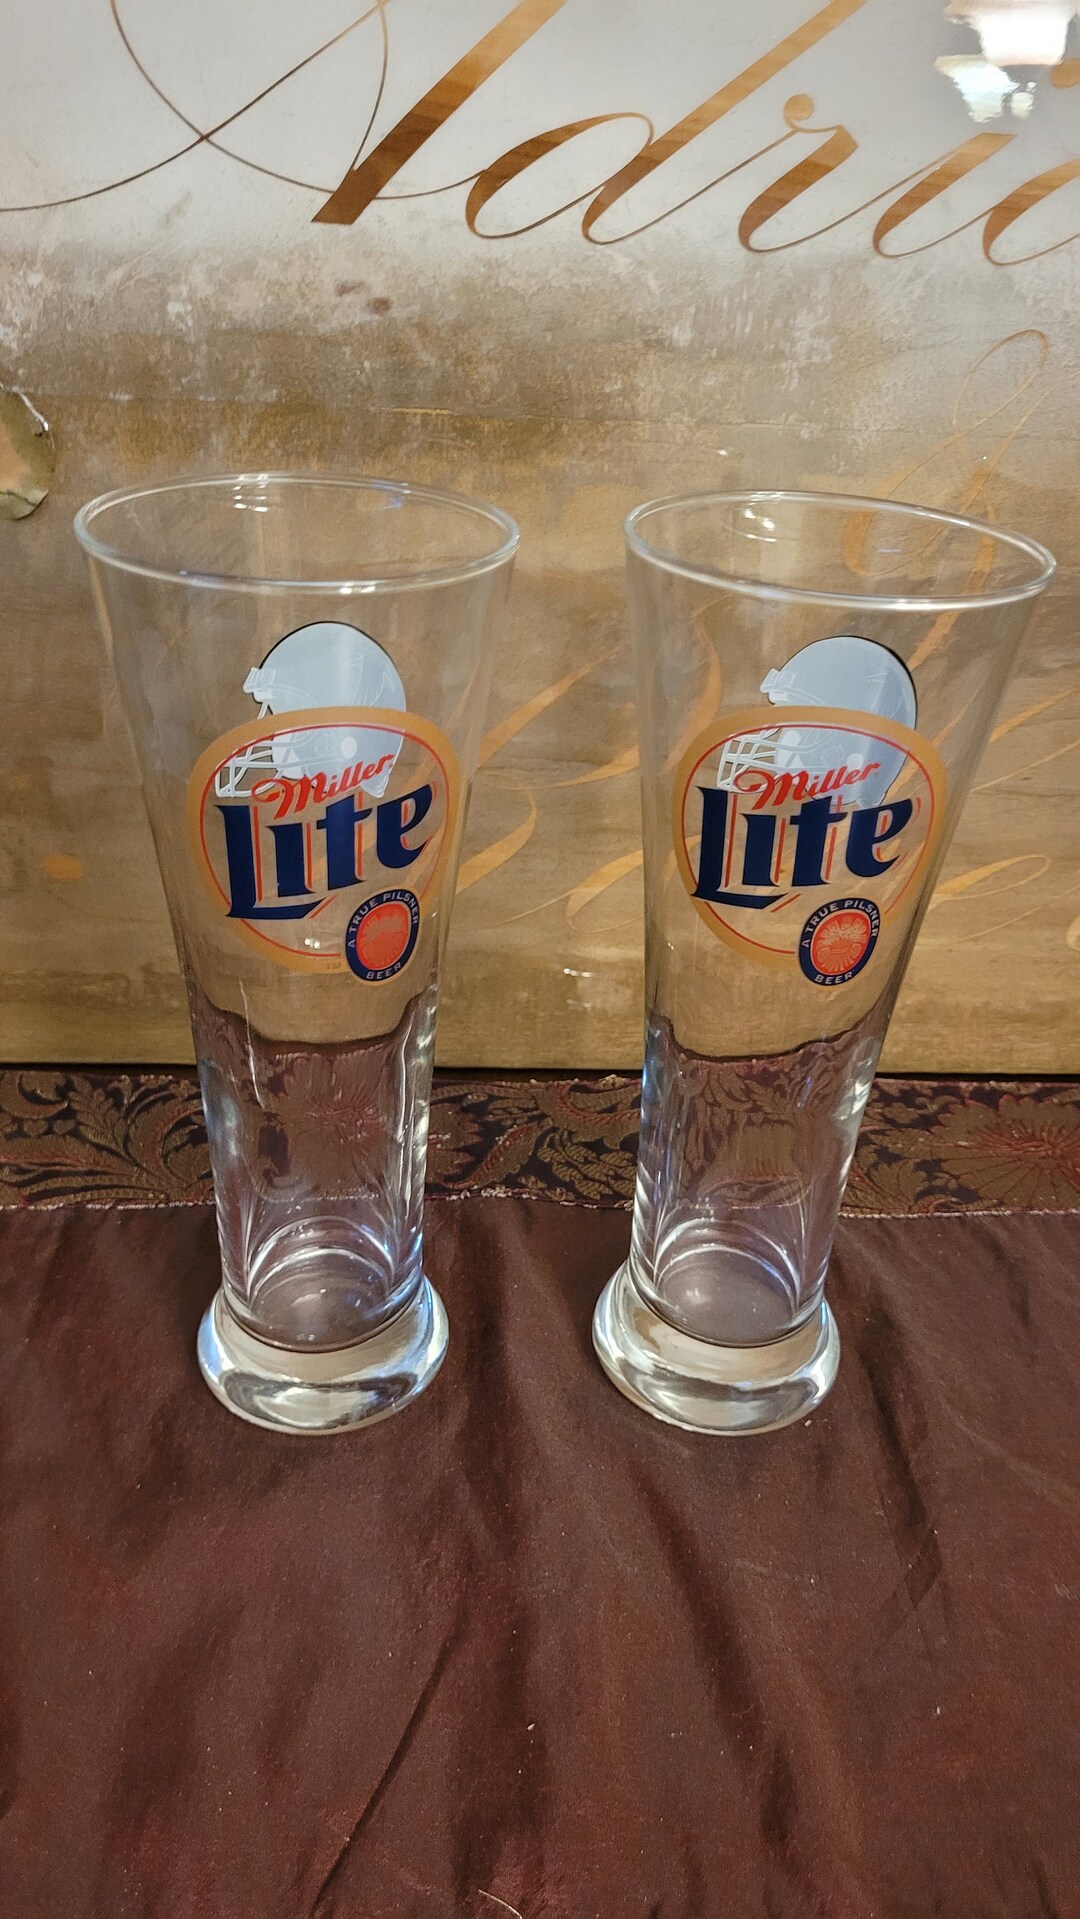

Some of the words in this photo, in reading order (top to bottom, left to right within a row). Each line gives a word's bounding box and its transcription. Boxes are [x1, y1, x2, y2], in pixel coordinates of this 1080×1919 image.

[251, 753, 395, 819] Miller
[733, 762, 882, 810] Miller
[214, 784, 436, 920] Lite
[690, 785, 914, 909] Lite
[348, 898, 378, 934] TRUE
[383, 891, 420, 924] PILSNER
[804, 902, 839, 934] TRUE
[844, 899, 880, 937] PILSNER
[347, 939, 356, 949] A
[801, 939, 811, 948] A
[366, 962, 401, 980] BEER
[814, 971, 853, 985] BEER
